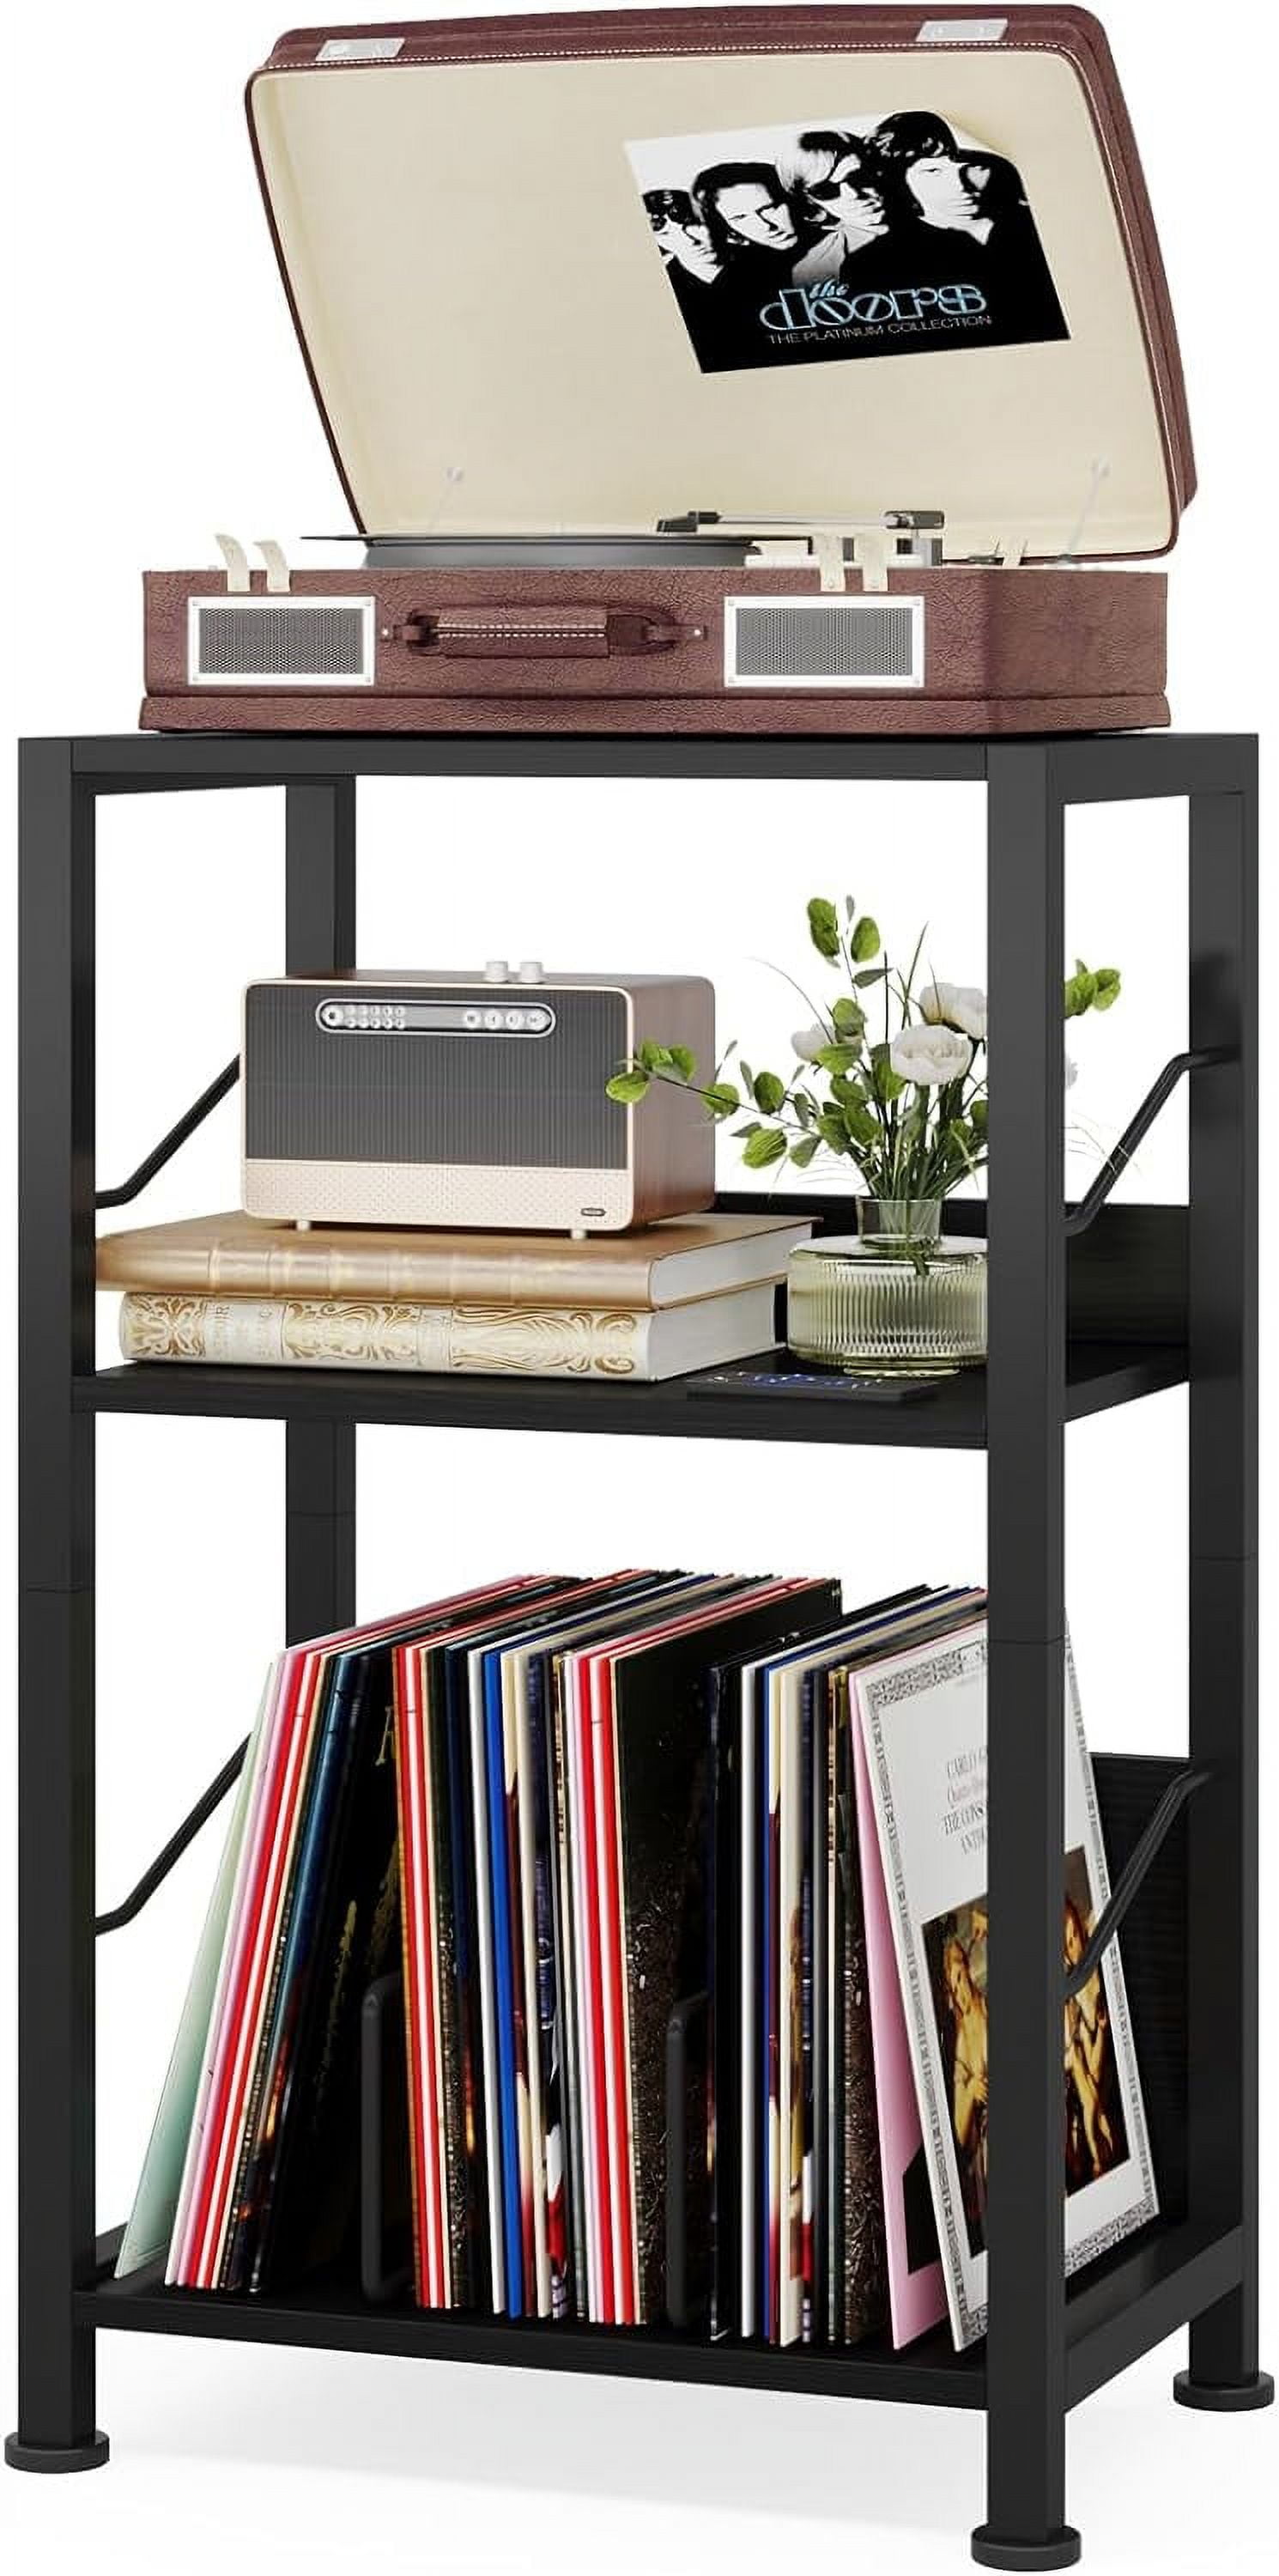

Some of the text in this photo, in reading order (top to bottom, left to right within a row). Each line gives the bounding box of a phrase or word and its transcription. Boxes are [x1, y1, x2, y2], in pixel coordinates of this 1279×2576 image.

[809, 278, 850, 299] the
[759, 284, 988, 331] doors
[769, 314, 992, 344] THE PLATINUM COLLECTION
